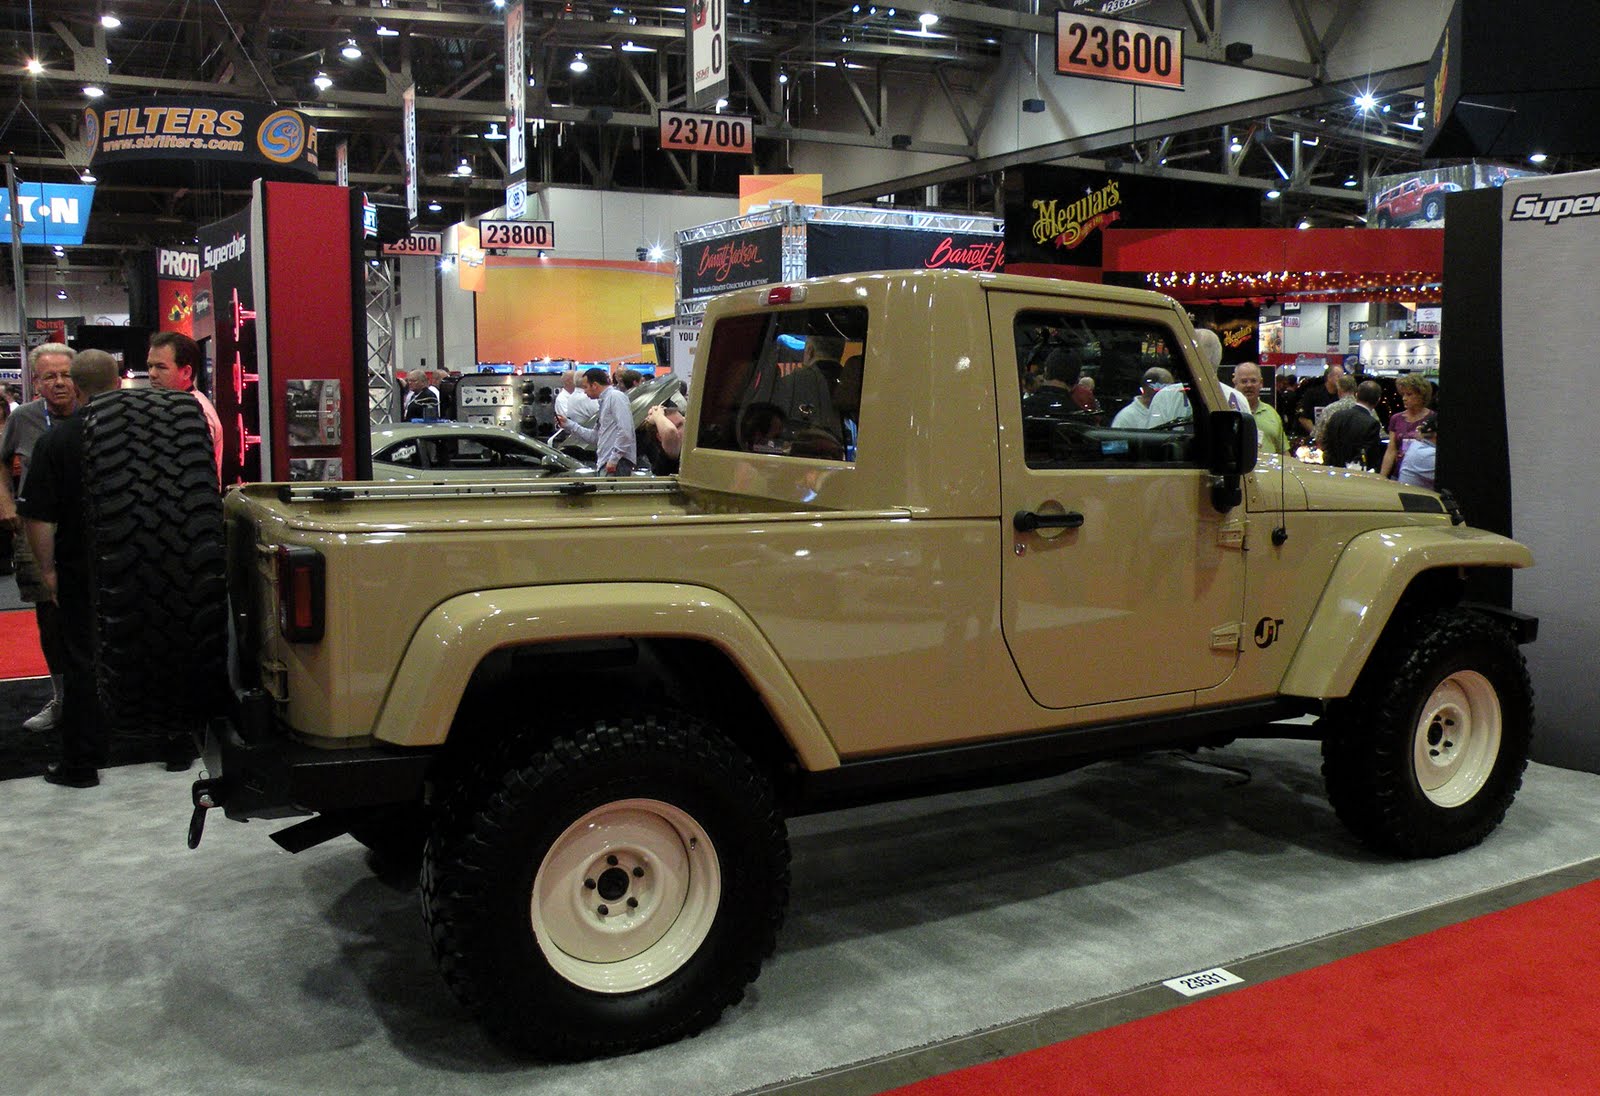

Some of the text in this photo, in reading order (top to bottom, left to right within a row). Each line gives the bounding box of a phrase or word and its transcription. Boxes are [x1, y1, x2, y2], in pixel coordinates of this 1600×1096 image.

[1068, 22, 1172, 76] 23600
[102, 106, 245, 137] FILTERS
[667, 116, 746, 148] 23700
[102, 134, 245, 152] www.sbfilters.com
[1032, 178, 1122, 245] Meguiar's
[486, 223, 547, 245] 23800
[204, 232, 246, 270] Superchips
[679, 332, 694, 341] YOU
[1406, 358, 1440, 366] MATS
[1180, 972, 1228, 990] 23531
